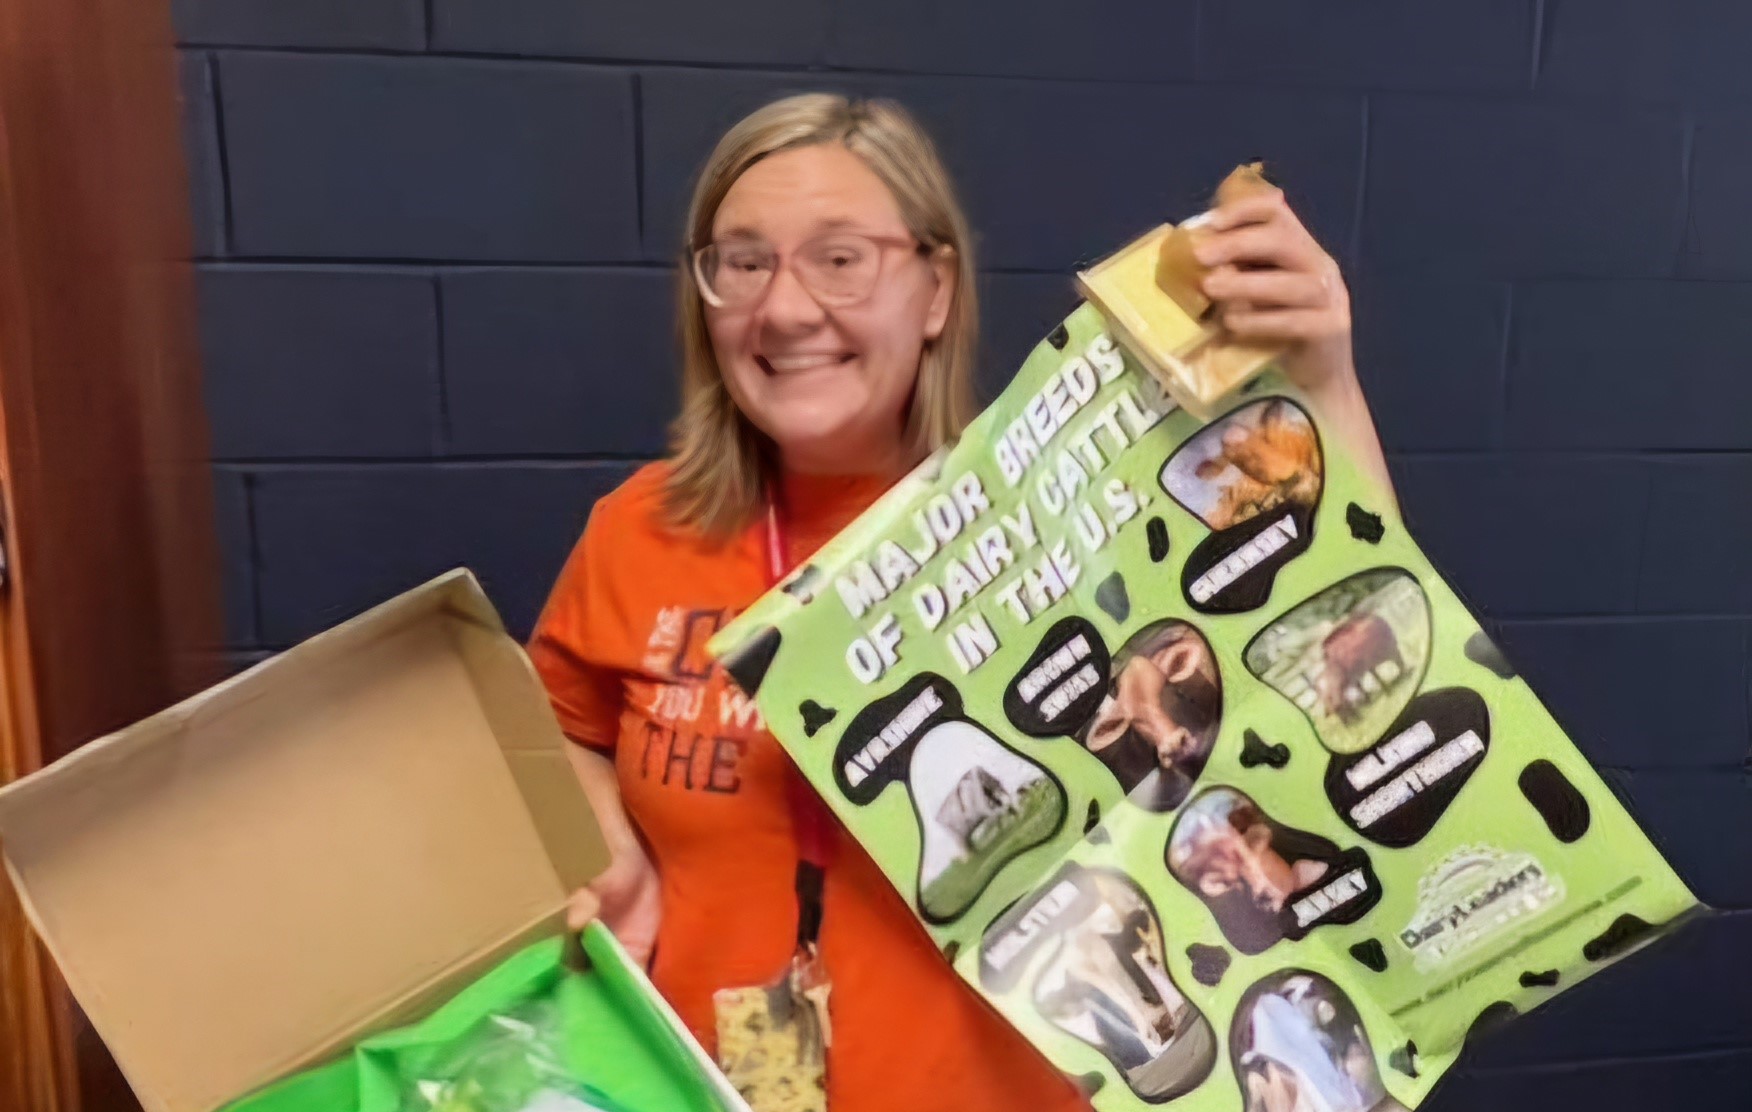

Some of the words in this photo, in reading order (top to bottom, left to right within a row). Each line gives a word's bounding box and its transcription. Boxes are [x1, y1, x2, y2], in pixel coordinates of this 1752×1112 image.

[835, 470, 992, 619] MAJOR
[994, 332, 1127, 489] BREEDS
[846, 612, 903, 685] OF
[911, 503, 1039, 633] DAIRY
[945, 612, 1001, 675] IN
[996, 538, 1082, 626] THE
[1073, 477, 1154, 553] U.S.
[641, 720, 747, 794] THE
